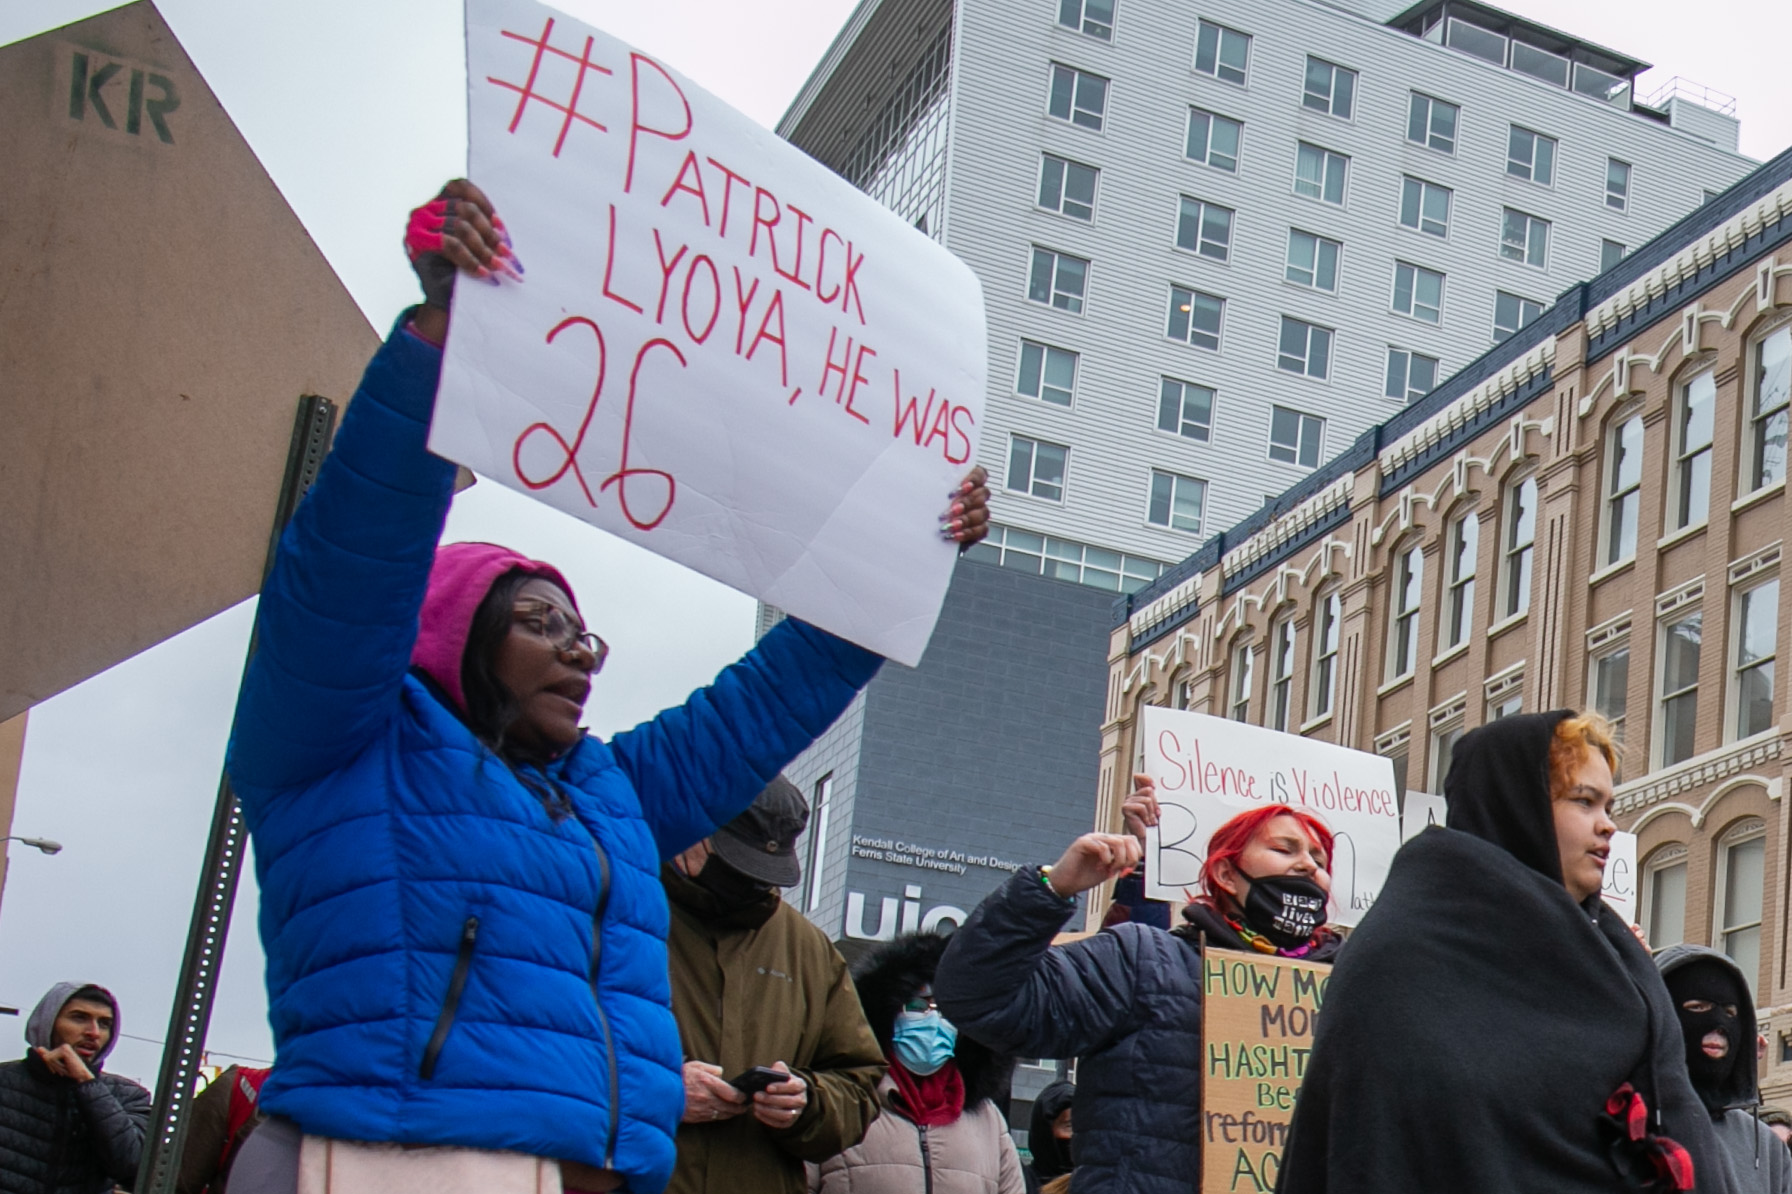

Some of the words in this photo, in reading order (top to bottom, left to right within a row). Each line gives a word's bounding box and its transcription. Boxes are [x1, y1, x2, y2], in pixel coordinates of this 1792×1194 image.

[69, 52, 181, 145] KR
[486, 17, 866, 326] #PATRICK
[602, 203, 803, 406] LYOYA,
[818, 325, 877, 426] HE
[893, 367, 975, 465] WAS
[513, 315, 688, 531] 26
[1158, 729, 1263, 800] Silence
[1269, 770, 1290, 804] is
[1292, 767, 1396, 818] Violence
[851, 846, 883, 861] Ferris
[885, 852, 914, 865] State
[915, 857, 967, 876] University
[852, 834, 893, 850] Kendall
[895, 841, 935, 860] College
[937, 849, 950, 860] of
[949, 850, 965, 864] Art
[967, 853, 988, 867] and
[1206, 959, 1281, 999] HOW
[1209, 1042, 1312, 1079] HASHT
